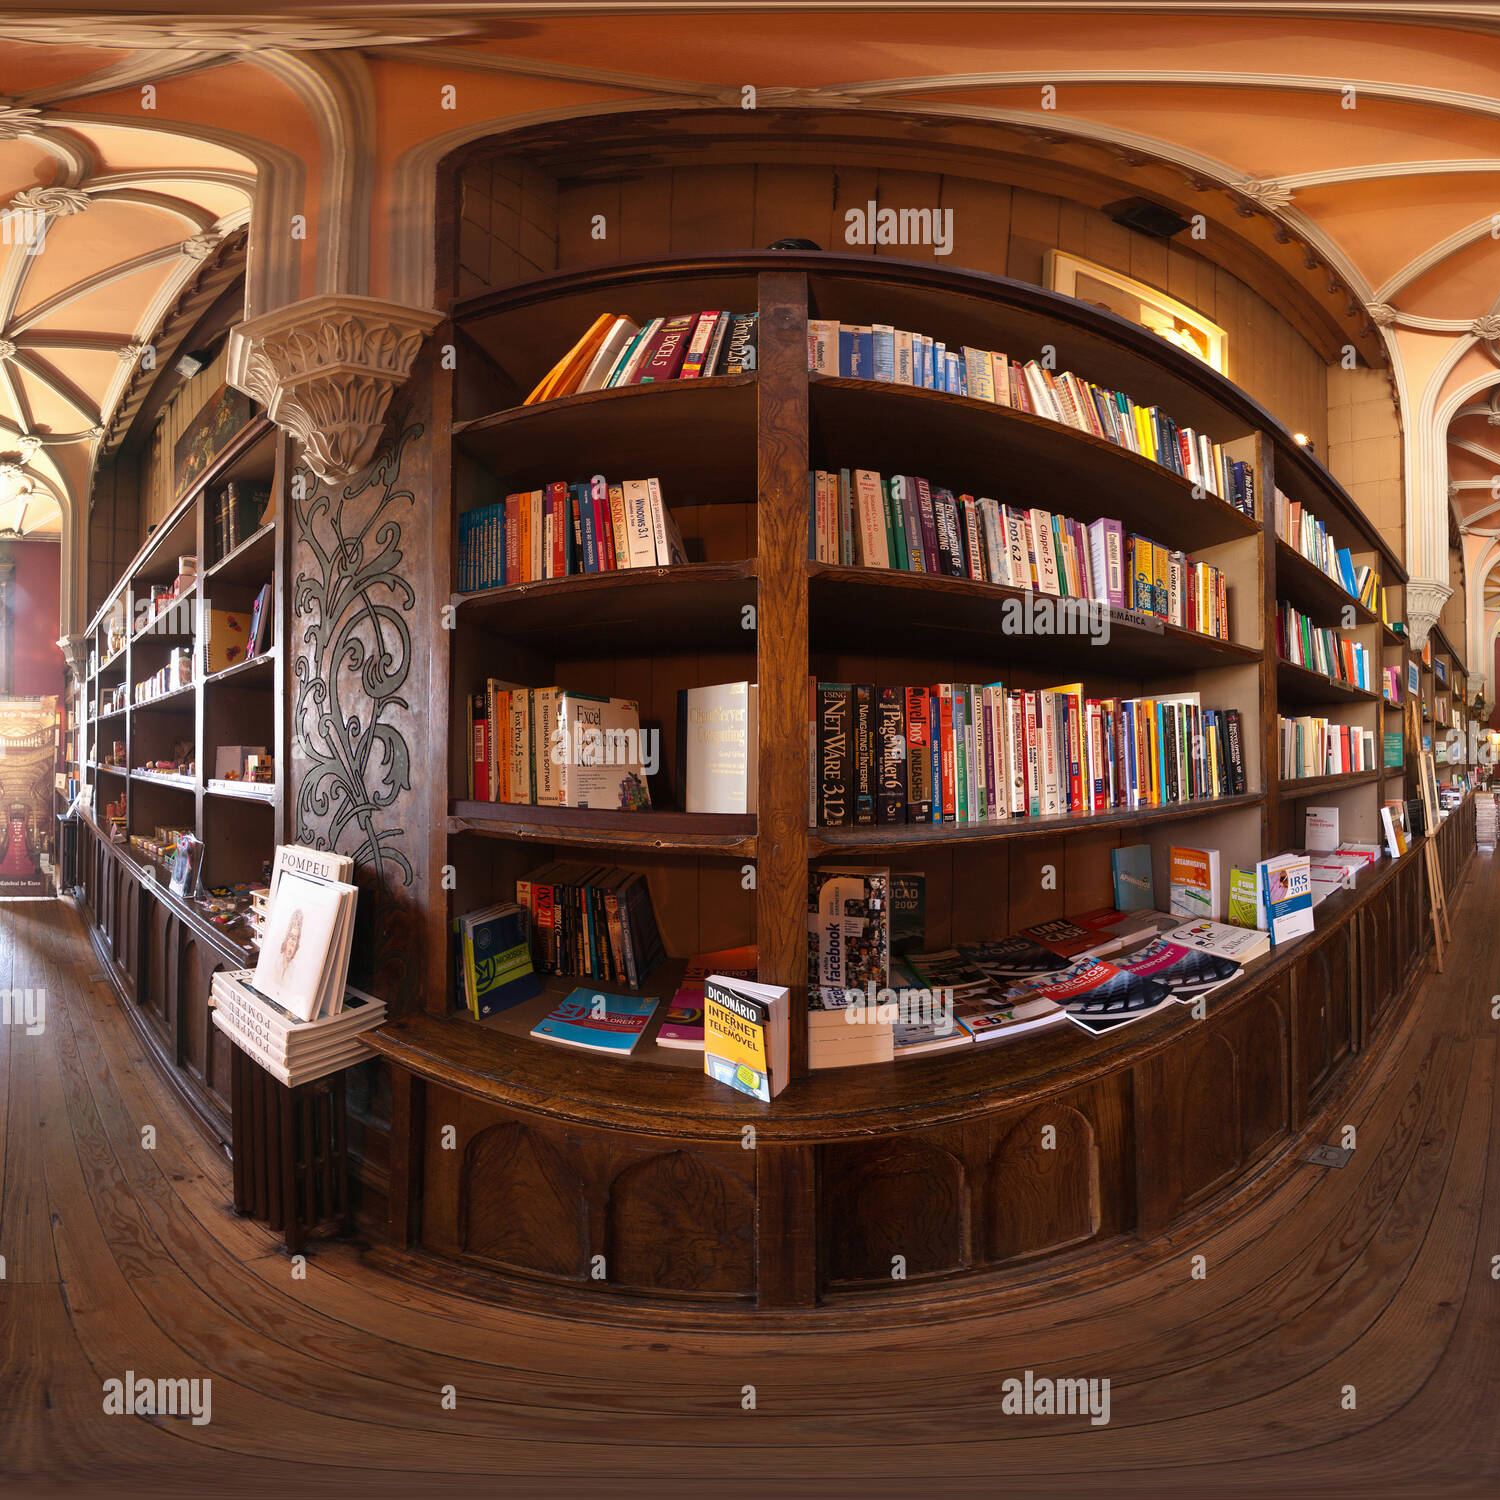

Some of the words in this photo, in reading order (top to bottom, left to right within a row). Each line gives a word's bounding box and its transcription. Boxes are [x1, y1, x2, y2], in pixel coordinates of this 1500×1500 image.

[1244, 476, 1252, 487] Web
[612, 497, 623, 523] MS-DOS
[918, 481, 931, 512] CLIPPER
[638, 528, 648, 538] 3.1
[935, 502, 949, 550] NETWORKING
[944, 504, 958, 556] ENCYCLOPEDIA
[952, 558, 961, 568] OF
[1009, 521, 1019, 542] DOS
[1040, 525, 1050, 554] Clipper
[1011, 545, 1021, 561] 6.2
[1044, 558, 1054, 574] 5.2
[577, 705, 600, 725] Excel
[859, 704, 869, 751] NAVIGATING
[514, 744, 523, 756] 2.5
[879, 711, 902, 779] PageMaker
[860, 756, 869, 794] INTERNET
[884, 780, 902, 788] 6
[912, 749, 922, 801] UNLEASHED
[823, 784, 846, 819] 3.12
[281, 852, 330, 878] POMPEU
[1290, 874, 1308, 887] IRS
[1290, 885, 1308, 895] 2011
[1029, 920, 1073, 936] UML
[1044, 927, 1088, 943] CASE
[826, 923, 841, 982] facebook
[1037, 966, 1104, 994] PROJECTOS
[231, 990, 270, 1029] POMPEU
[708, 986, 756, 1022] DICIONÁRIO
[230, 1002, 269, 1041] POMPEU
[230, 1013, 269, 1053] POMPEU
[708, 1005, 757, 1038] INTERNET
[709, 1019, 758, 1051] TELEMÓVEL
